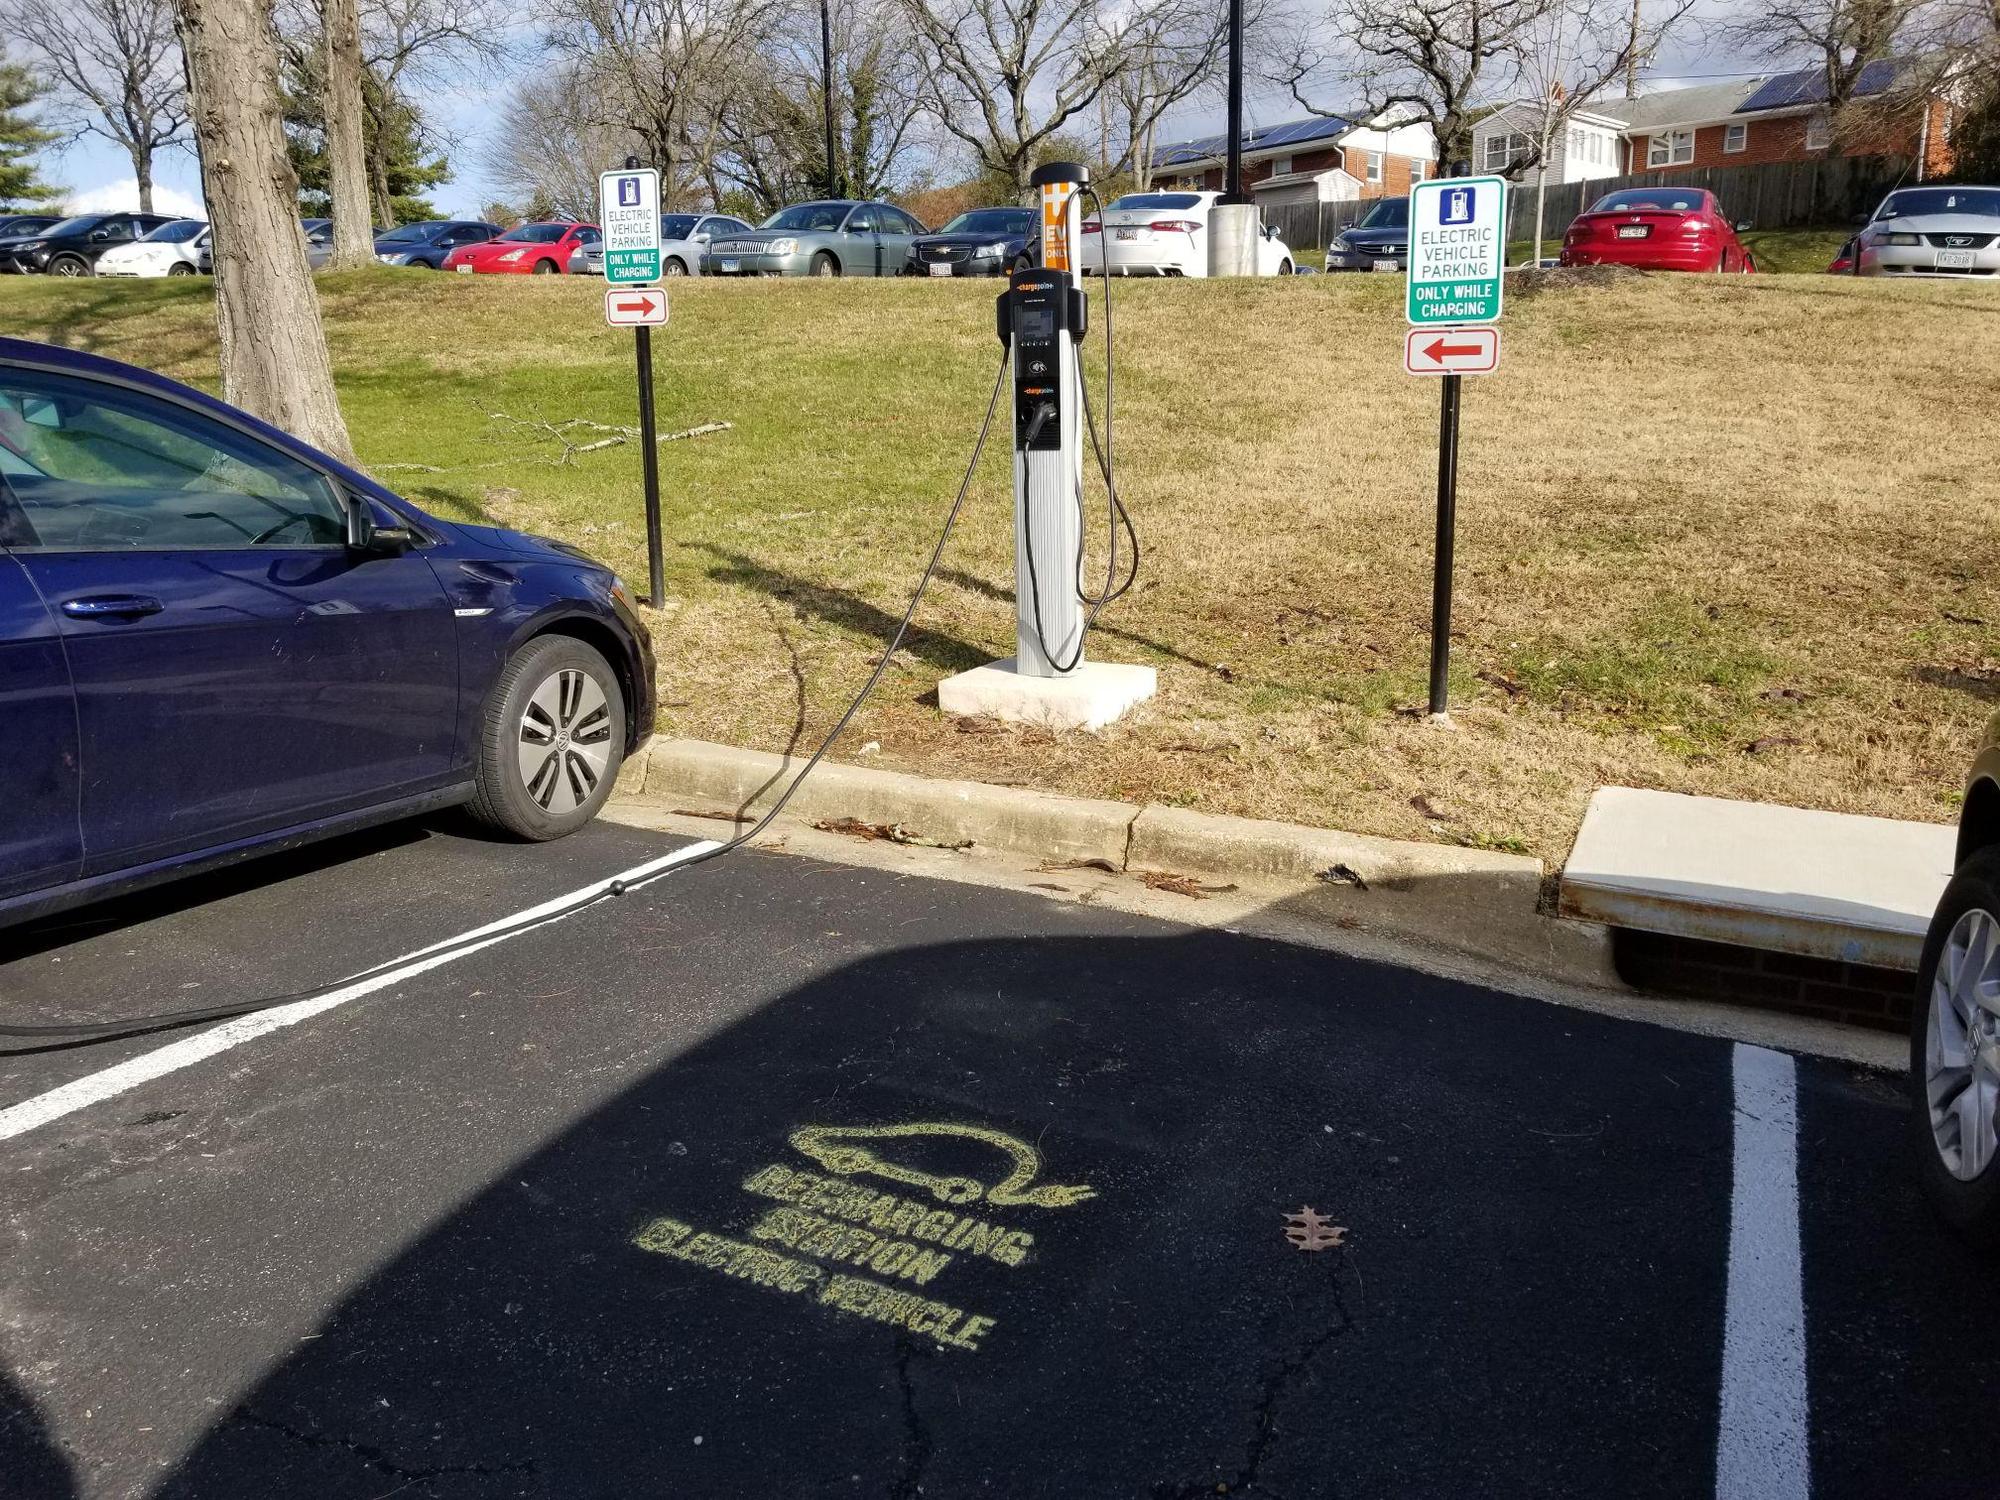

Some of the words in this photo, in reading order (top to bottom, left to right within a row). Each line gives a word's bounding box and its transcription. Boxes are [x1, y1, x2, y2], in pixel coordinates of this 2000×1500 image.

[608, 209, 652, 222] ELECTRIC
[612, 222, 651, 235] VEHICLE
[1046, 224, 1067, 241] EV
[1421, 227, 1492, 245] ELECTRIC
[611, 236, 652, 248] PARKING
[609, 253, 630, 265] ONLY
[632, 252, 656, 265] WHILE
[1425, 245, 1488, 261] VEHICLE
[614, 266, 653, 278] CHARGING
[1422, 262, 1488, 279] PARKING
[1416, 285, 1450, 301] ONLY
[1454, 283, 1493, 299] WHILE
[1421, 301, 1486, 318] CHARGING
[742, 1163, 1035, 1268] RECHARGING
[751, 1206, 953, 1286] STATION
[632, 1217, 823, 1293] ELECTRIC
[821, 1274, 997, 1350] VEHICLE
